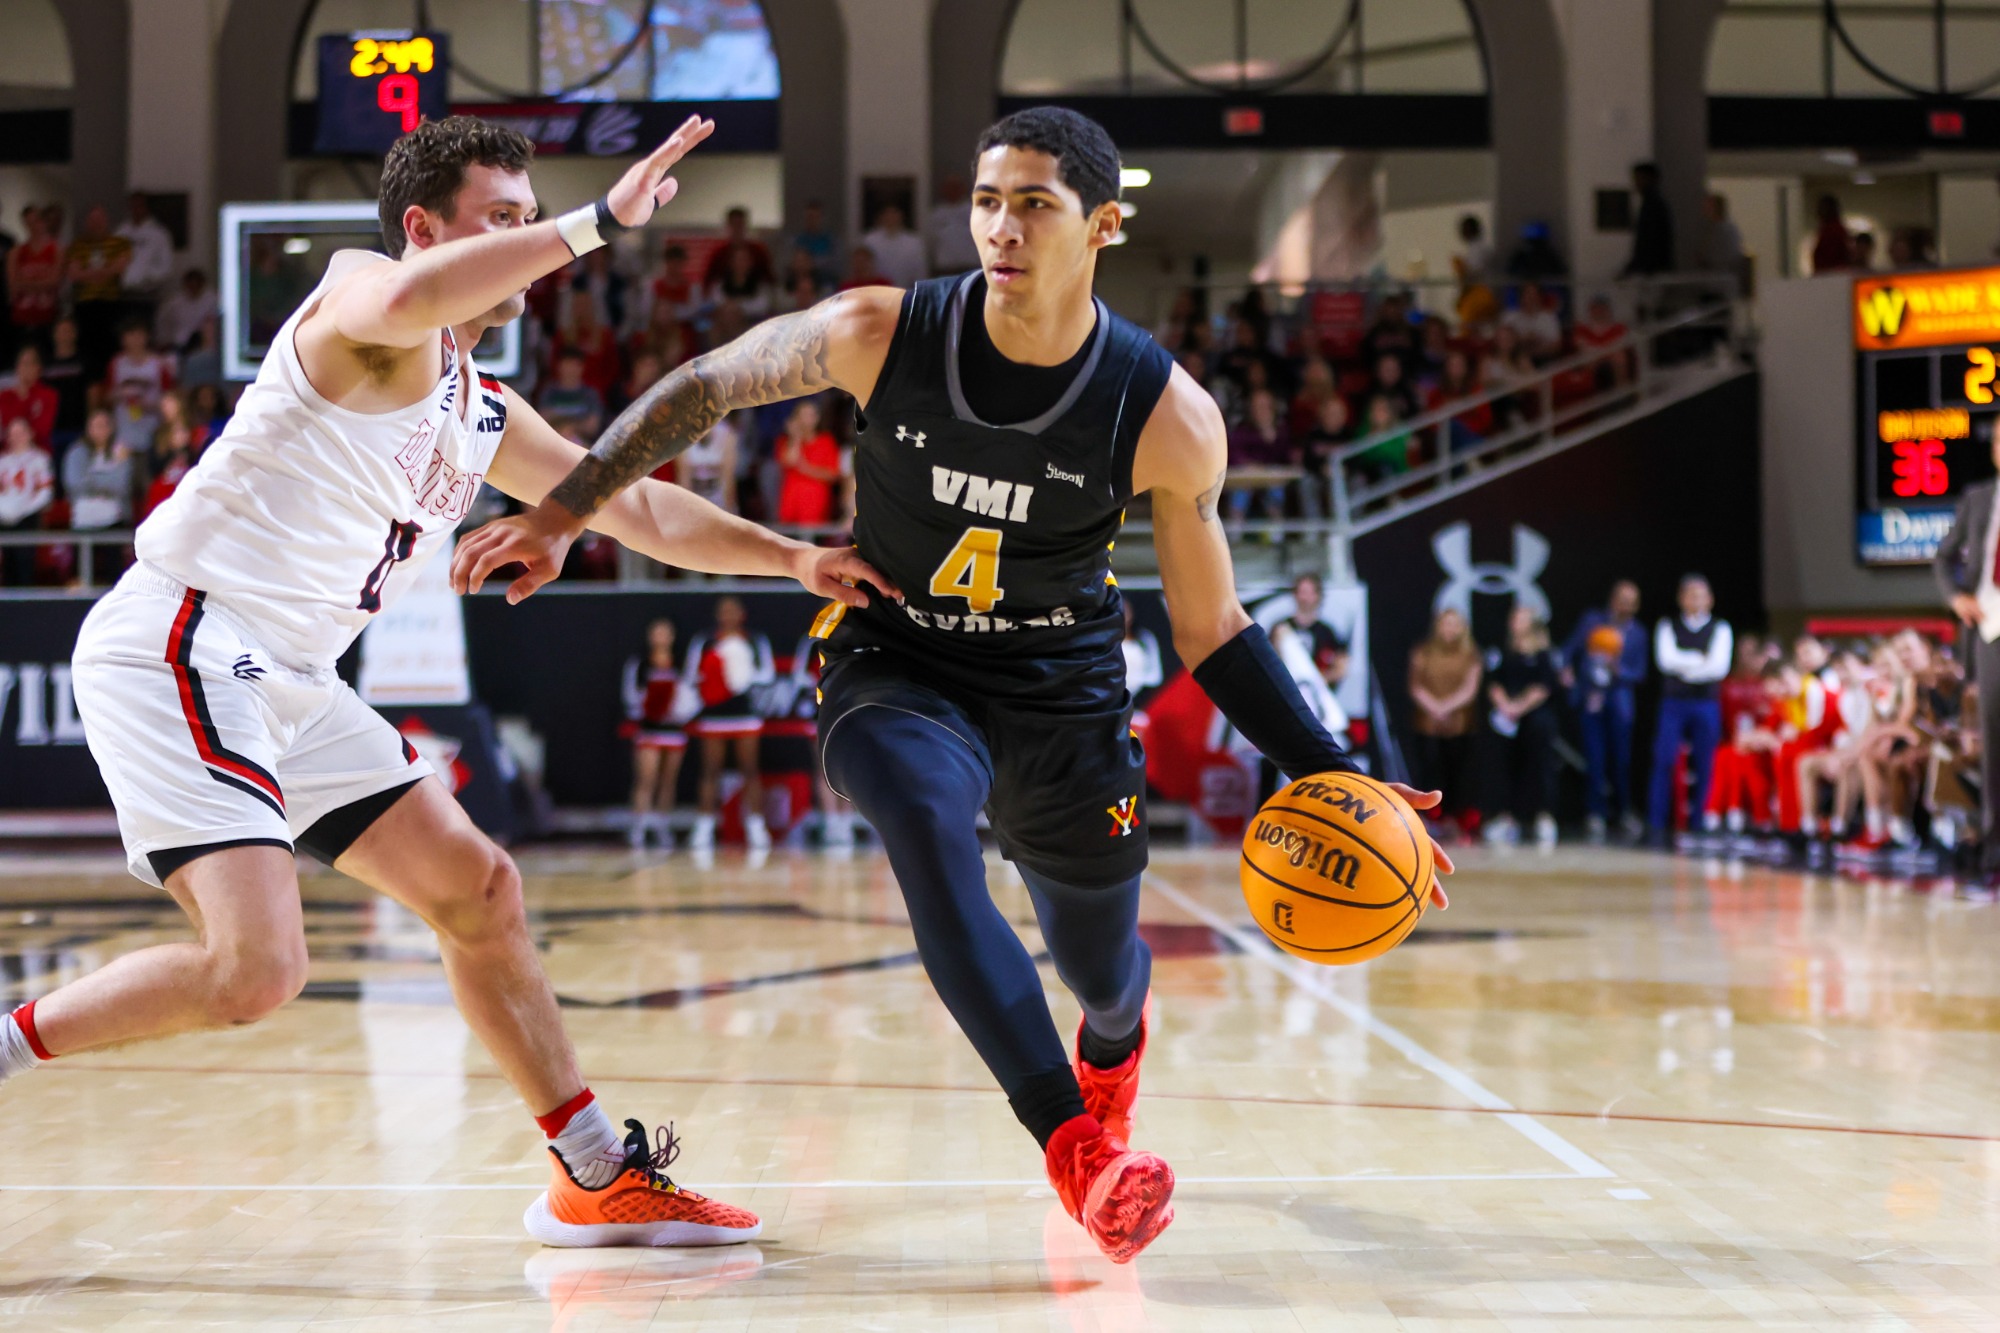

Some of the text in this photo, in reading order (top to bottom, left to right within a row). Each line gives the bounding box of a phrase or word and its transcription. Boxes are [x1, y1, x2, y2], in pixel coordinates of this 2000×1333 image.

[377, 73, 419, 132] 9
[1861, 286, 1905, 337] W
[931, 465, 1034, 523] VMI
[1891, 437, 1949, 497] 36
[929, 526, 1004, 614] 4
[1290, 780, 1379, 825] NCAA
[1254, 819, 1362, 892] Wilson
